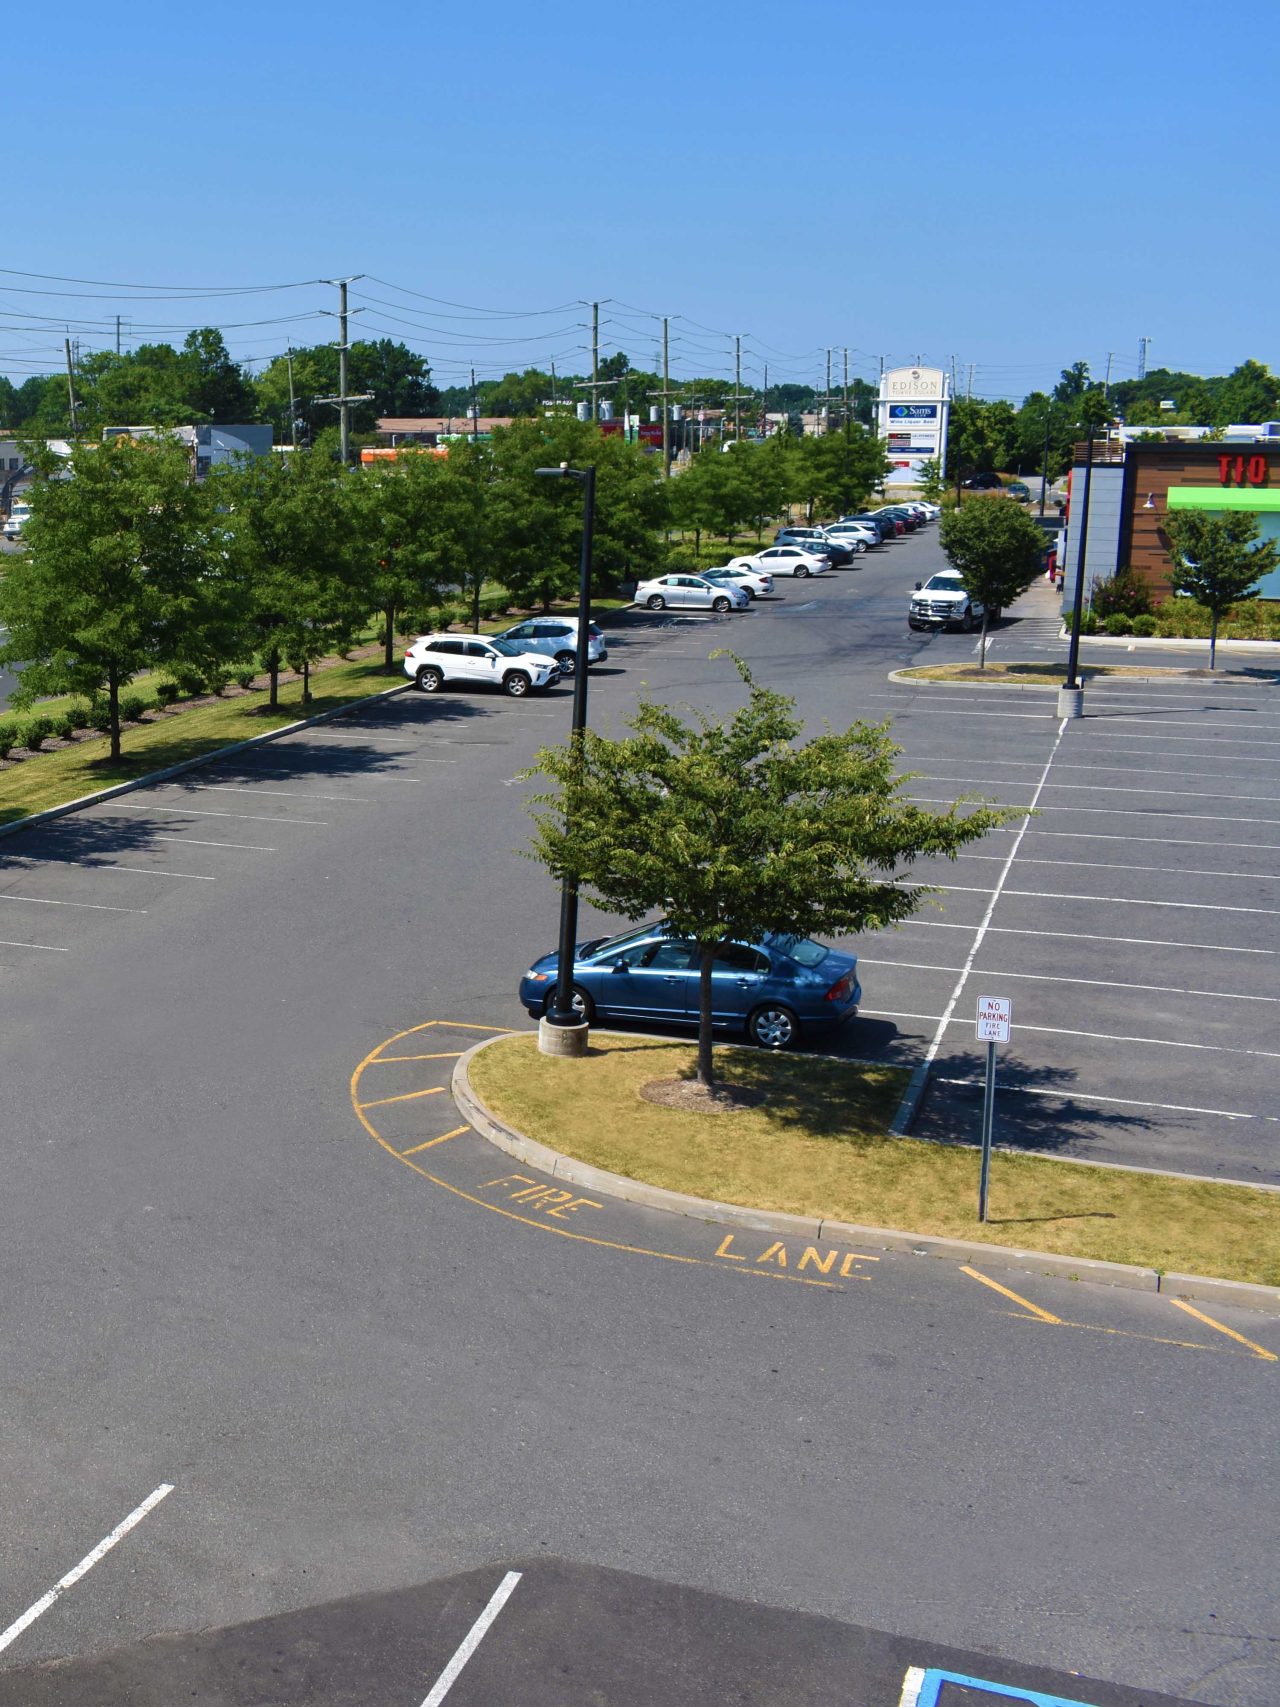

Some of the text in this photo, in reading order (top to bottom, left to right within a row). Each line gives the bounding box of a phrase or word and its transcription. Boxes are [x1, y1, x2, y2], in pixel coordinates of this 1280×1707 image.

[892, 382, 937, 390] EDISON
[1217, 454, 1267, 484] TIO
[988, 1002, 1000, 1011] NO
[980, 1011, 1008, 1022] PARKING
[985, 1022, 1000, 1030] FIRE
[477, 1174, 880, 1281] FIRE LANE
